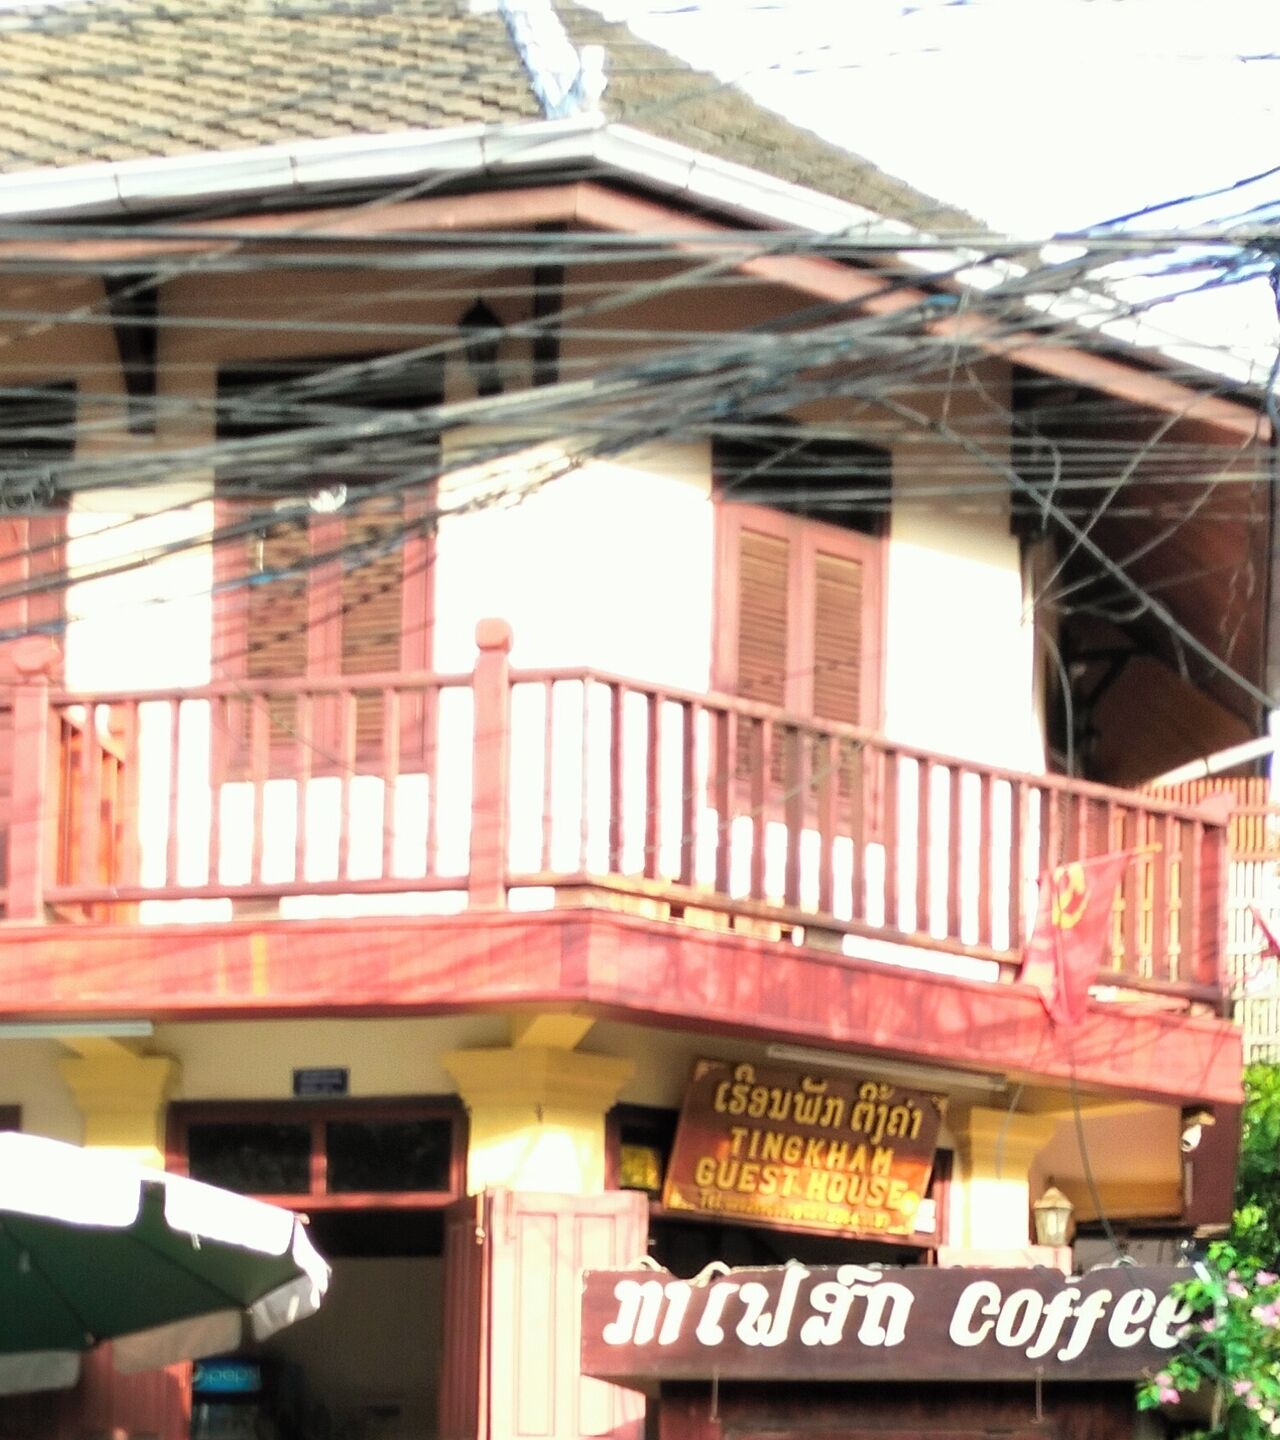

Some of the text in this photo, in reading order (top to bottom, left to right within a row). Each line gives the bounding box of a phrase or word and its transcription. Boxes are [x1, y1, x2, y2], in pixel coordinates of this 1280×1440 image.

[729, 1126, 895, 1176] TINGKHAM
[695, 1156, 800, 1197] GUEST
[806, 1168, 909, 1211] HOUSE
[949, 1280, 1194, 1362] Coffee
